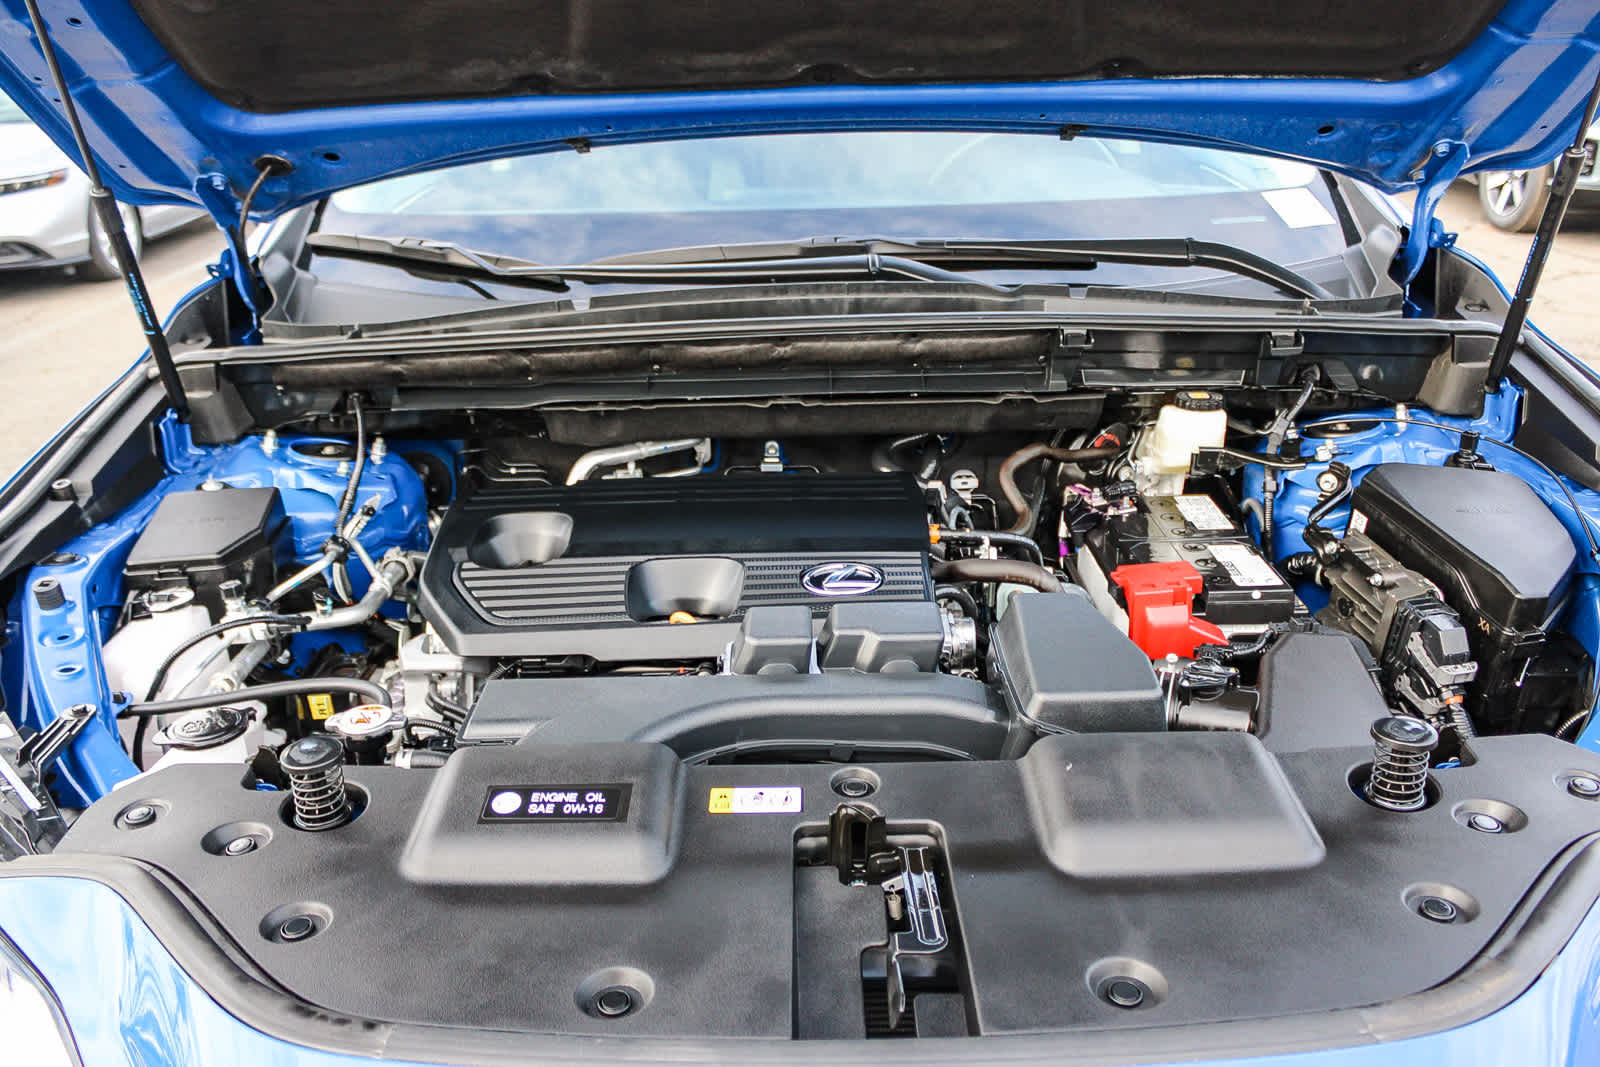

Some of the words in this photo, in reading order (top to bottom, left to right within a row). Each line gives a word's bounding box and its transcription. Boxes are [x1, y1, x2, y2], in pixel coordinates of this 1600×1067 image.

[530, 792, 578, 803] ENGINE
[585, 792, 606, 803] OIL
[528, 803, 555, 814] SAE
[563, 803, 604, 814] 0W-16
